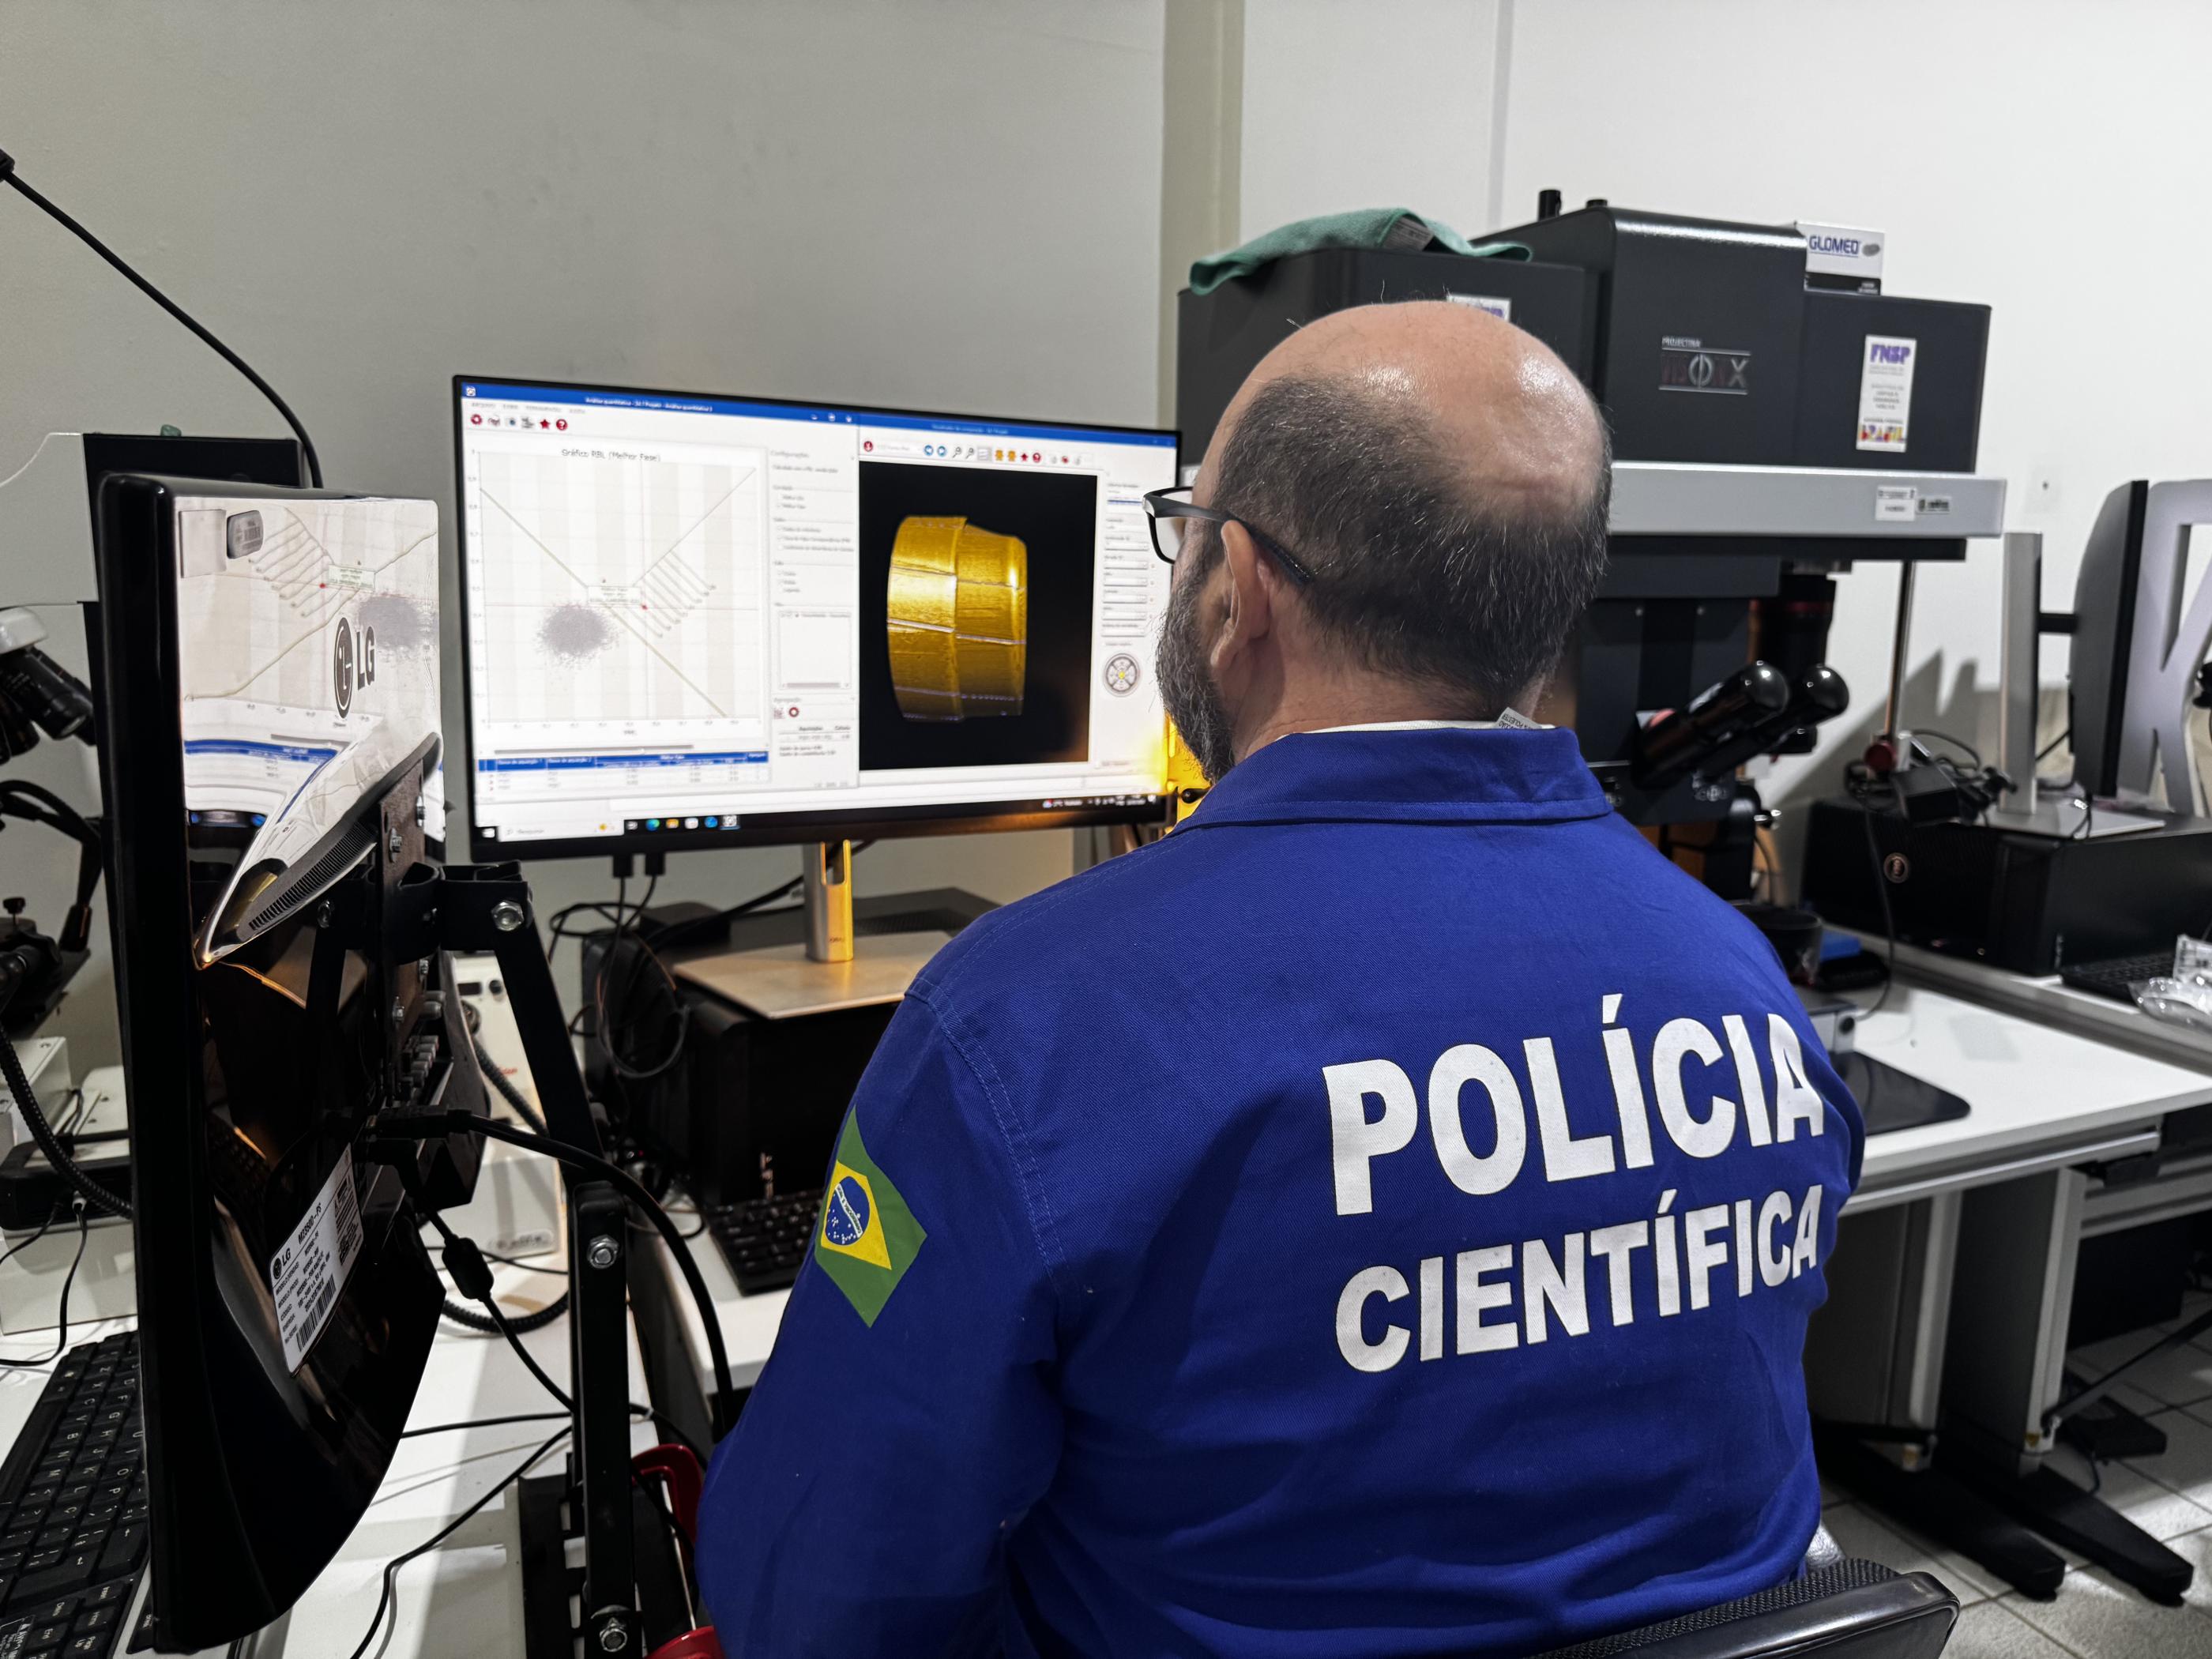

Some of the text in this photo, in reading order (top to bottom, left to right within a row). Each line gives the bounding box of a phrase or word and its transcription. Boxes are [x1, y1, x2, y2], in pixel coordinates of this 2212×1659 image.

[1809, 235, 1859, 254] GLOMED
[1871, 344, 1911, 363] FNSP
[357, 626, 376, 690] LG
[1322, 993, 1824, 1215] POLÍCIA
[282, 1247, 291, 1267] LG
[1335, 1184, 1823, 1372] CIENTÍFICA
[49, 1469, 61, 1477] M
